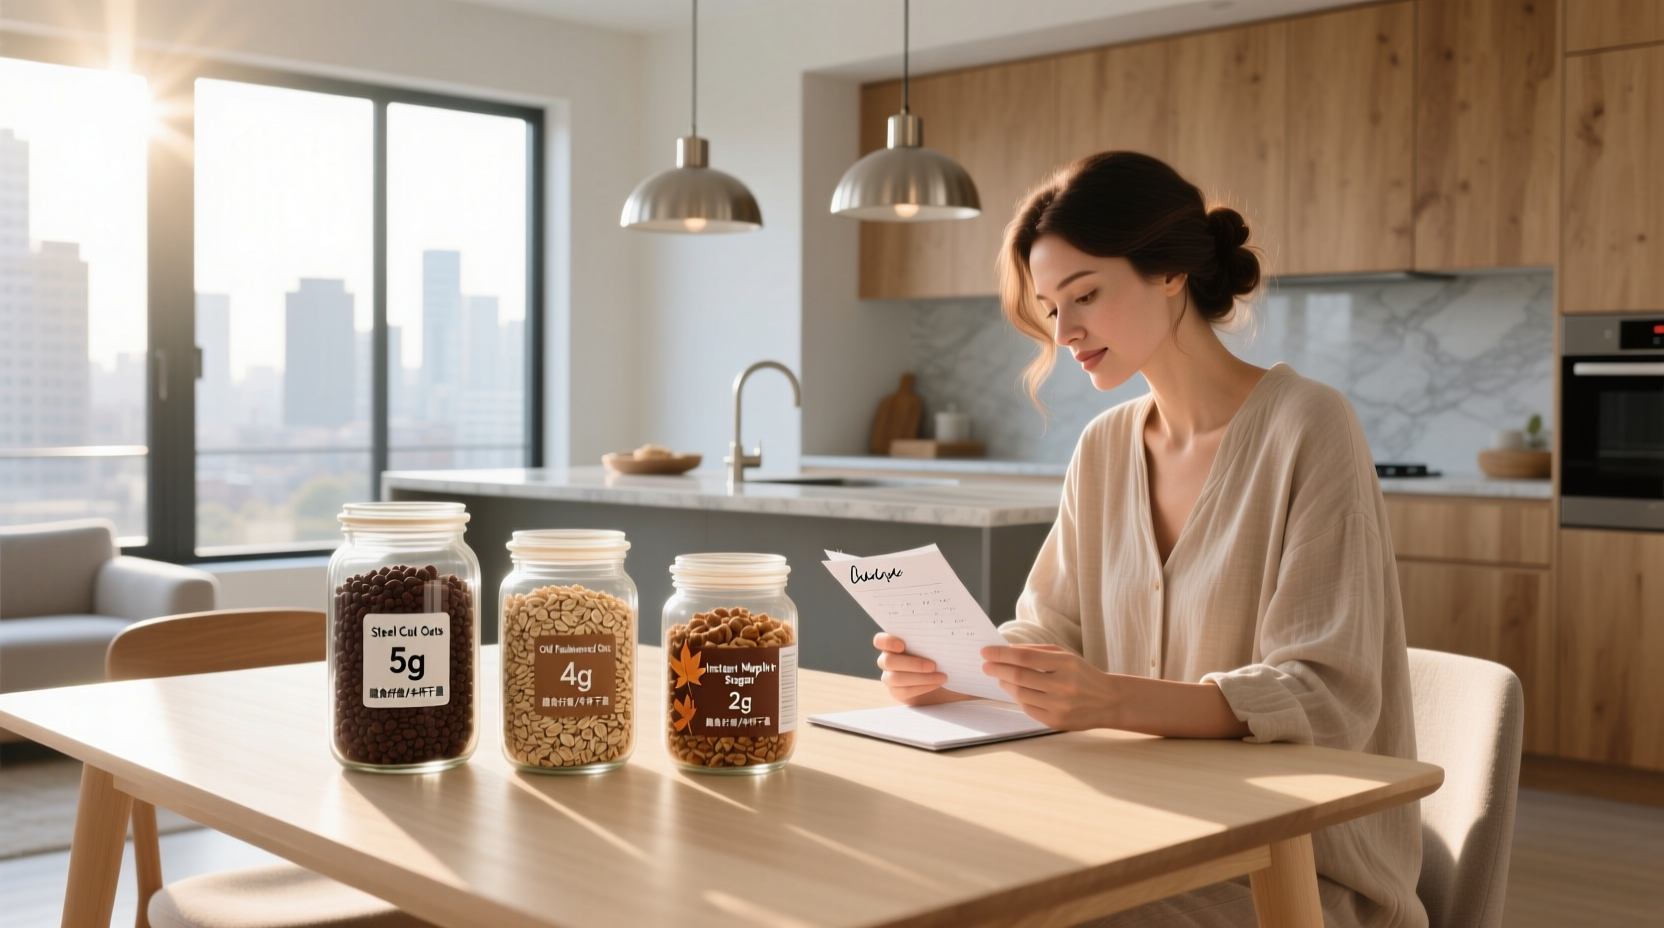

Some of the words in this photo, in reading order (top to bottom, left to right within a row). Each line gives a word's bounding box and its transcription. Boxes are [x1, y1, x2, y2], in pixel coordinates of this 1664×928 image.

[389, 646, 425, 681] 5g
[560, 661, 592, 692] 4g
[728, 691, 752, 714] 2g
